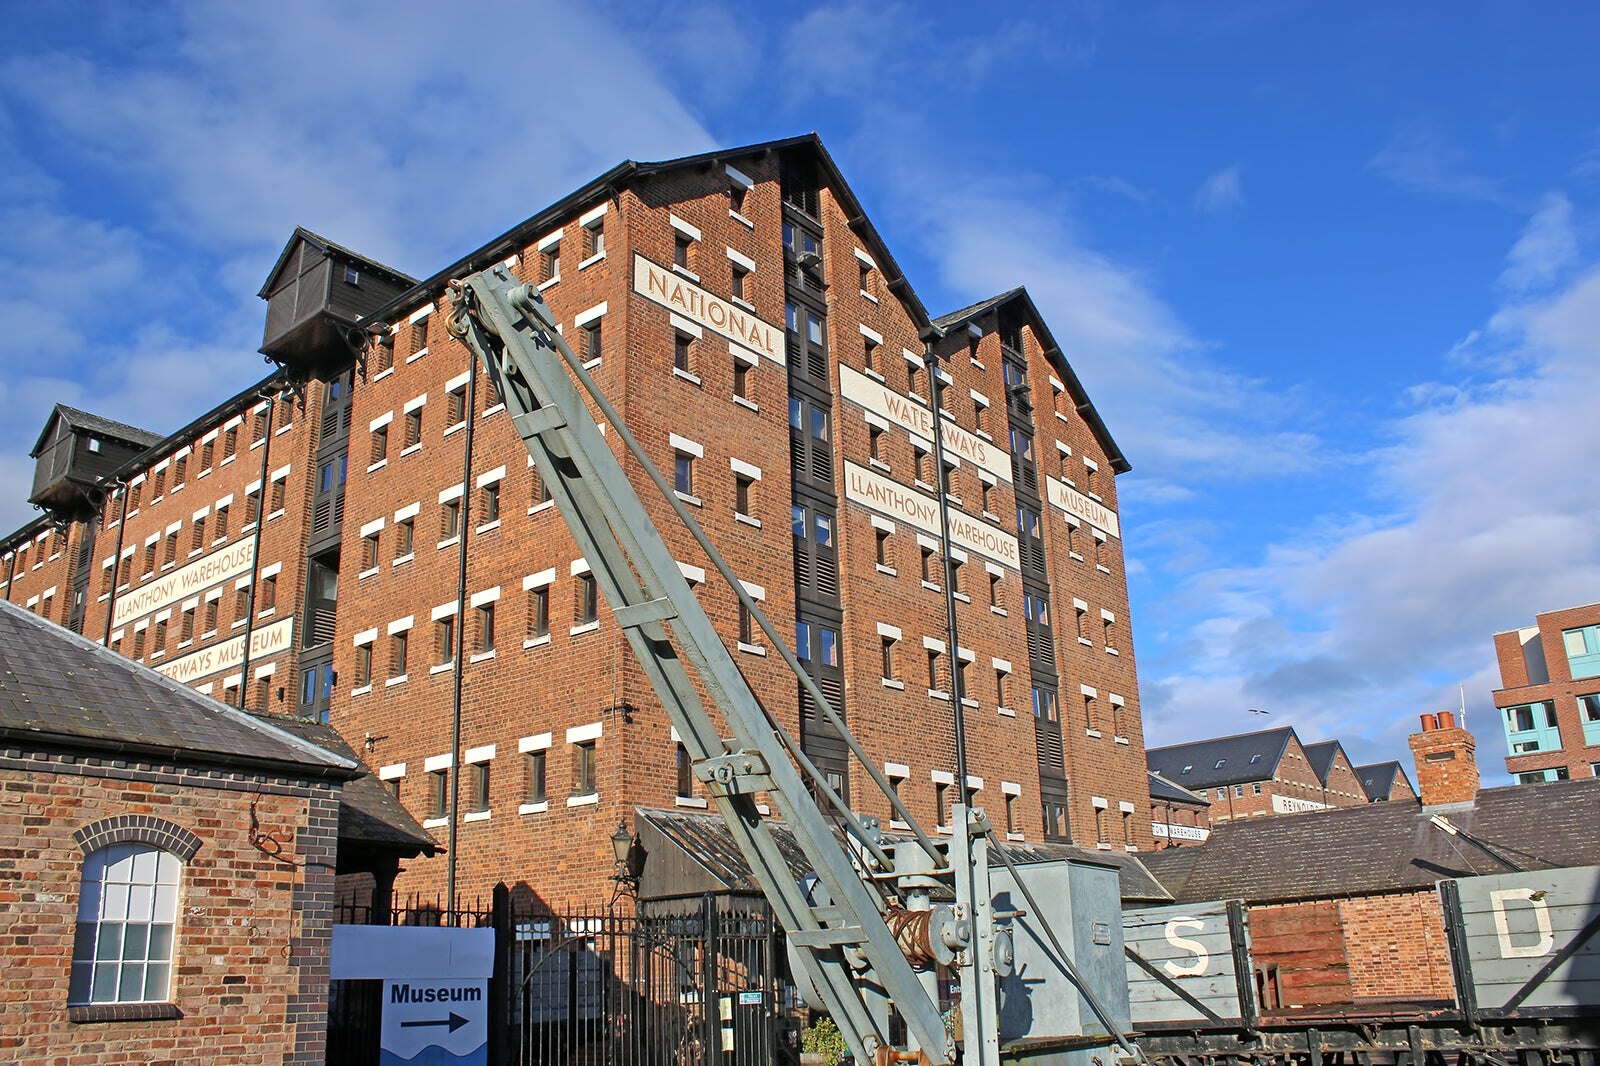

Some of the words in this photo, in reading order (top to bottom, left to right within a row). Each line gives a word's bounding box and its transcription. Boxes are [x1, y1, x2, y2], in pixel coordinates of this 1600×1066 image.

[647, 265, 775, 355] NATIONAL
[883, 391, 987, 465] WATEWAYS
[851, 472, 936, 525] LLANTHONY
[1060, 489, 1110, 530] MUSEUM
[117, 579, 176, 619] LLANTHONY
[182, 543, 253, 588] WAREHOUSE
[160, 651, 212, 679] ERWAYS
[1163, 916, 1210, 978] S
[1490, 888, 1553, 958] D
[391, 984, 481, 1003] Museum
